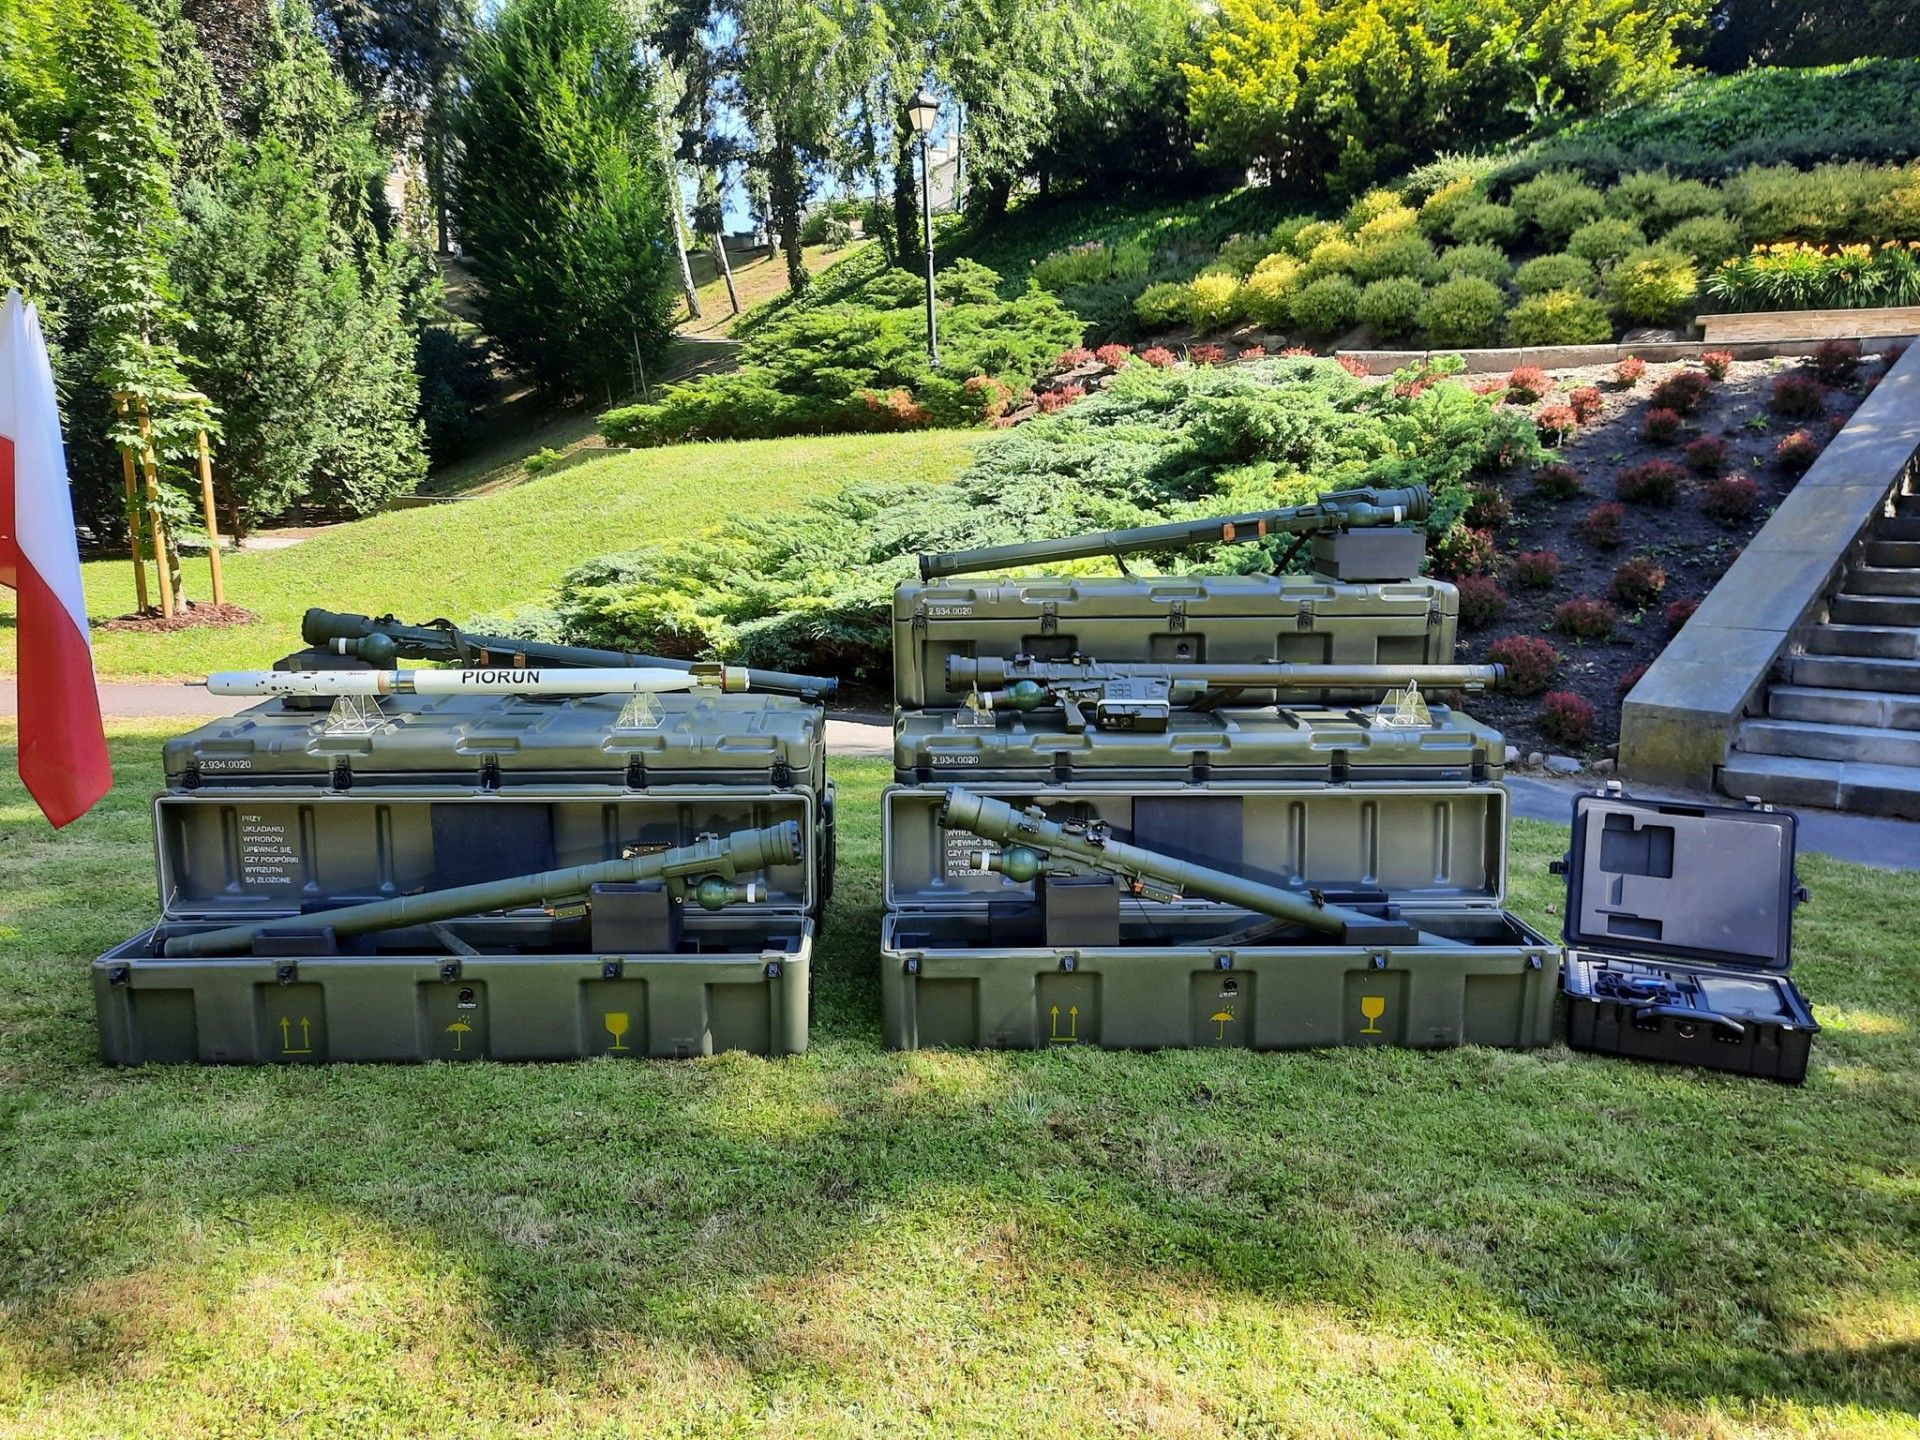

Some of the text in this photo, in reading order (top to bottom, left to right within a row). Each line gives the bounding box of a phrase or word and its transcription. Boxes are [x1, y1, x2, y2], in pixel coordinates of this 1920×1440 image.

[461, 670, 540, 684] PIORUN
[200, 760, 252, 769] 2.934.0020
[242, 825, 285, 833] UKŁADANIU
[947, 838, 981, 847] UPEWNIĆ
[243, 845, 292, 854] UPEWNIĆ SIĘ
[947, 849, 962, 857] CZY
